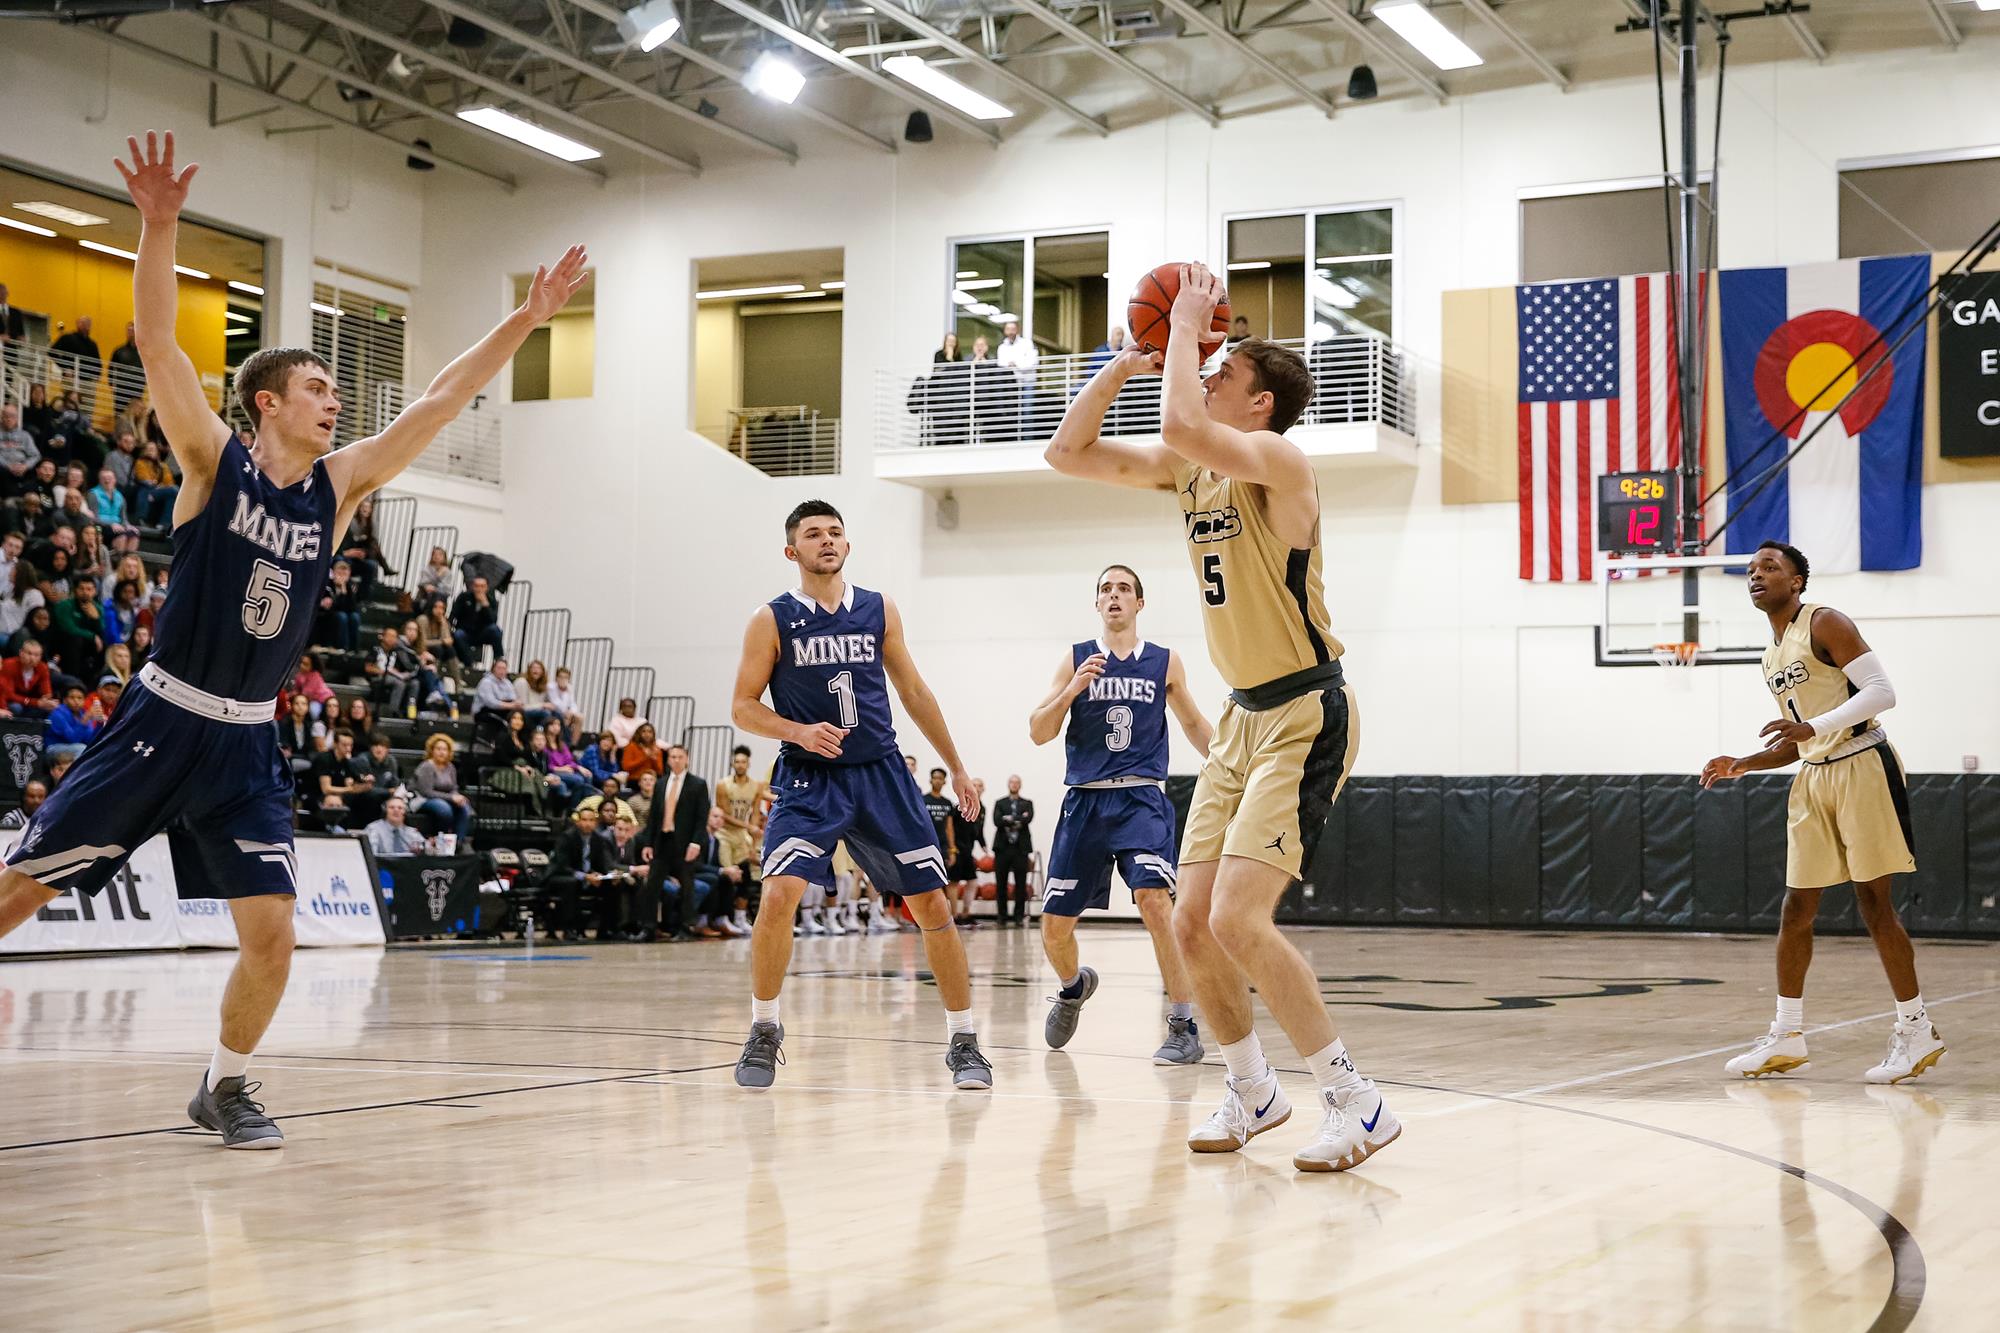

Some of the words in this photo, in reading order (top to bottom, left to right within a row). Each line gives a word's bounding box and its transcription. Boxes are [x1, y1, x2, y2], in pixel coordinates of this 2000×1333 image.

[1952, 297, 2000, 326] GA
[1980, 349, 2000, 375] E
[1620, 477, 1664, 500] 9:26
[228, 490, 322, 561] MNES
[1627, 505, 1660, 545] 12
[1203, 553, 1227, 608] 5
[242, 558, 291, 639] 5
[791, 633, 876, 667] MINES
[1088, 676, 1157, 704] MINES
[1767, 660, 1810, 695] CCS
[828, 671, 858, 728] 1
[1105, 705, 1133, 752] 3
[311, 892, 371, 915] thrive
